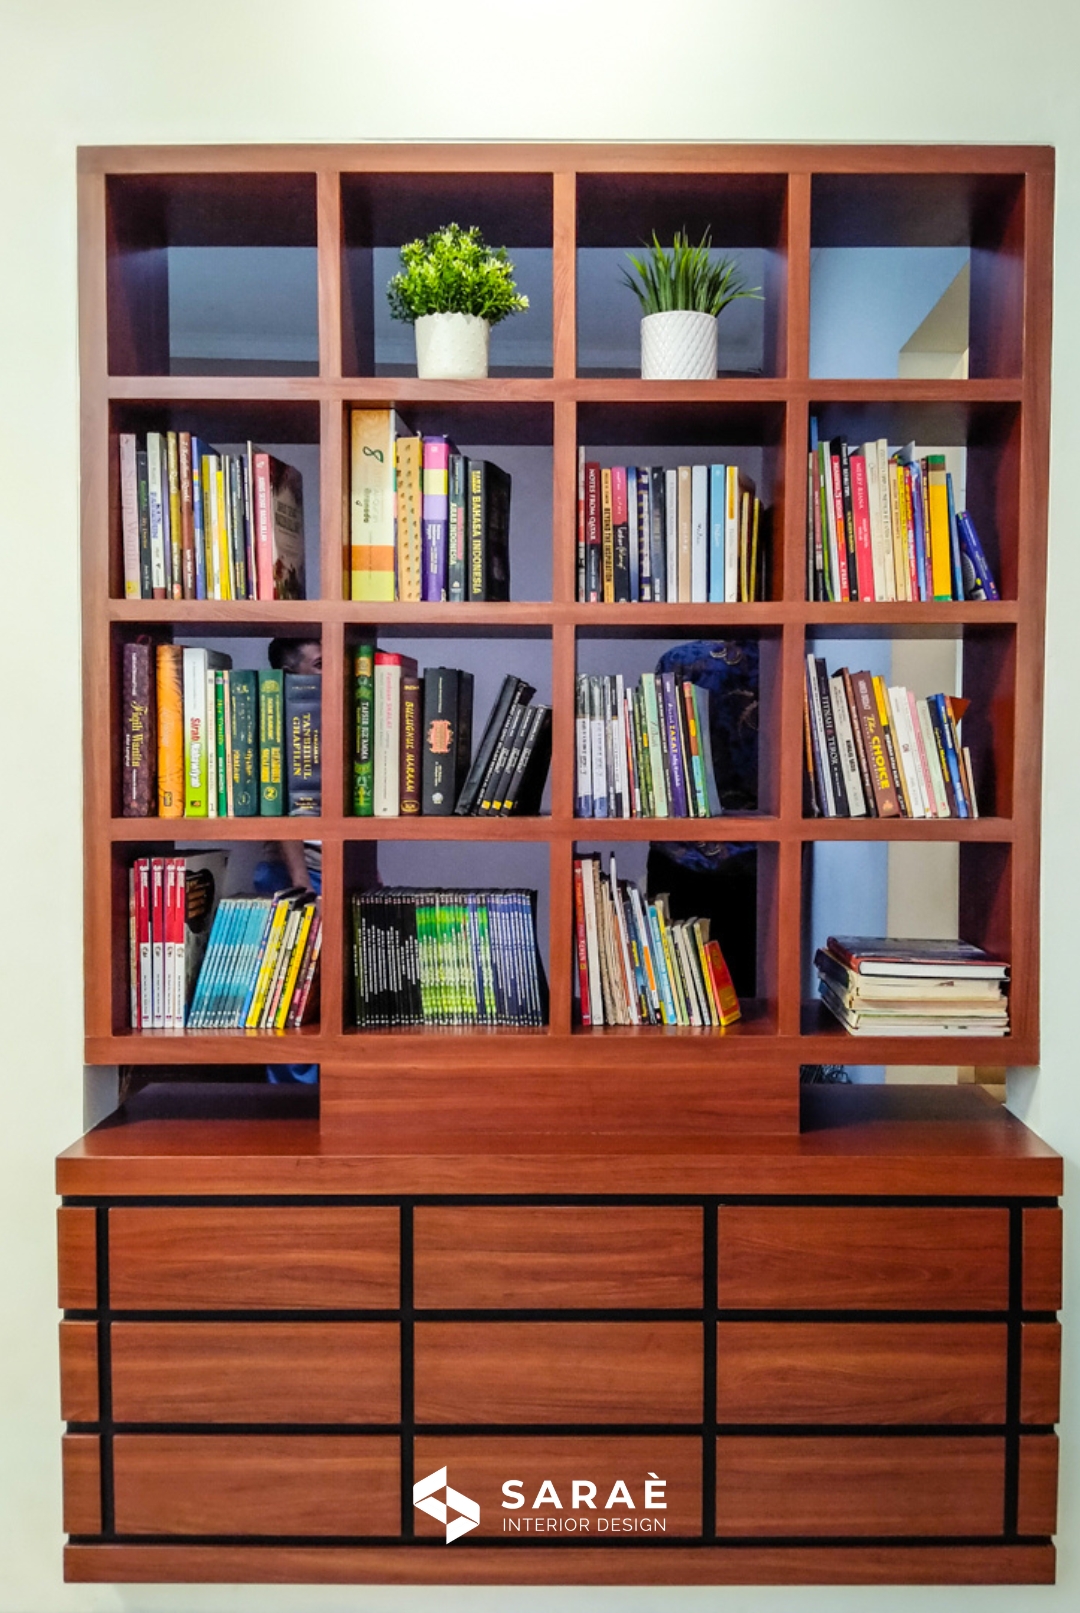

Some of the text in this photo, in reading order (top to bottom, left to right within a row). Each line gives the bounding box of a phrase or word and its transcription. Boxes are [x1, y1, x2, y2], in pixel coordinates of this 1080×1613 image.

[588, 468, 596, 492] NOTES
[472, 496, 481, 537] BAHASA
[588, 517, 597, 540] QATAR
[473, 540, 482, 594] INDONESIA
[361, 702, 369, 725] TAFSIR
[131, 734, 144, 767] Wanita
[292, 717, 301, 776] GHAFILIN
[303, 713, 312, 780] TANBIHUL
[669, 725, 678, 753] ZAKAT
[828, 735, 838, 765] TEROR
[867, 714, 890, 789] The CHOICE
[406, 753, 415, 792] MARAAM
